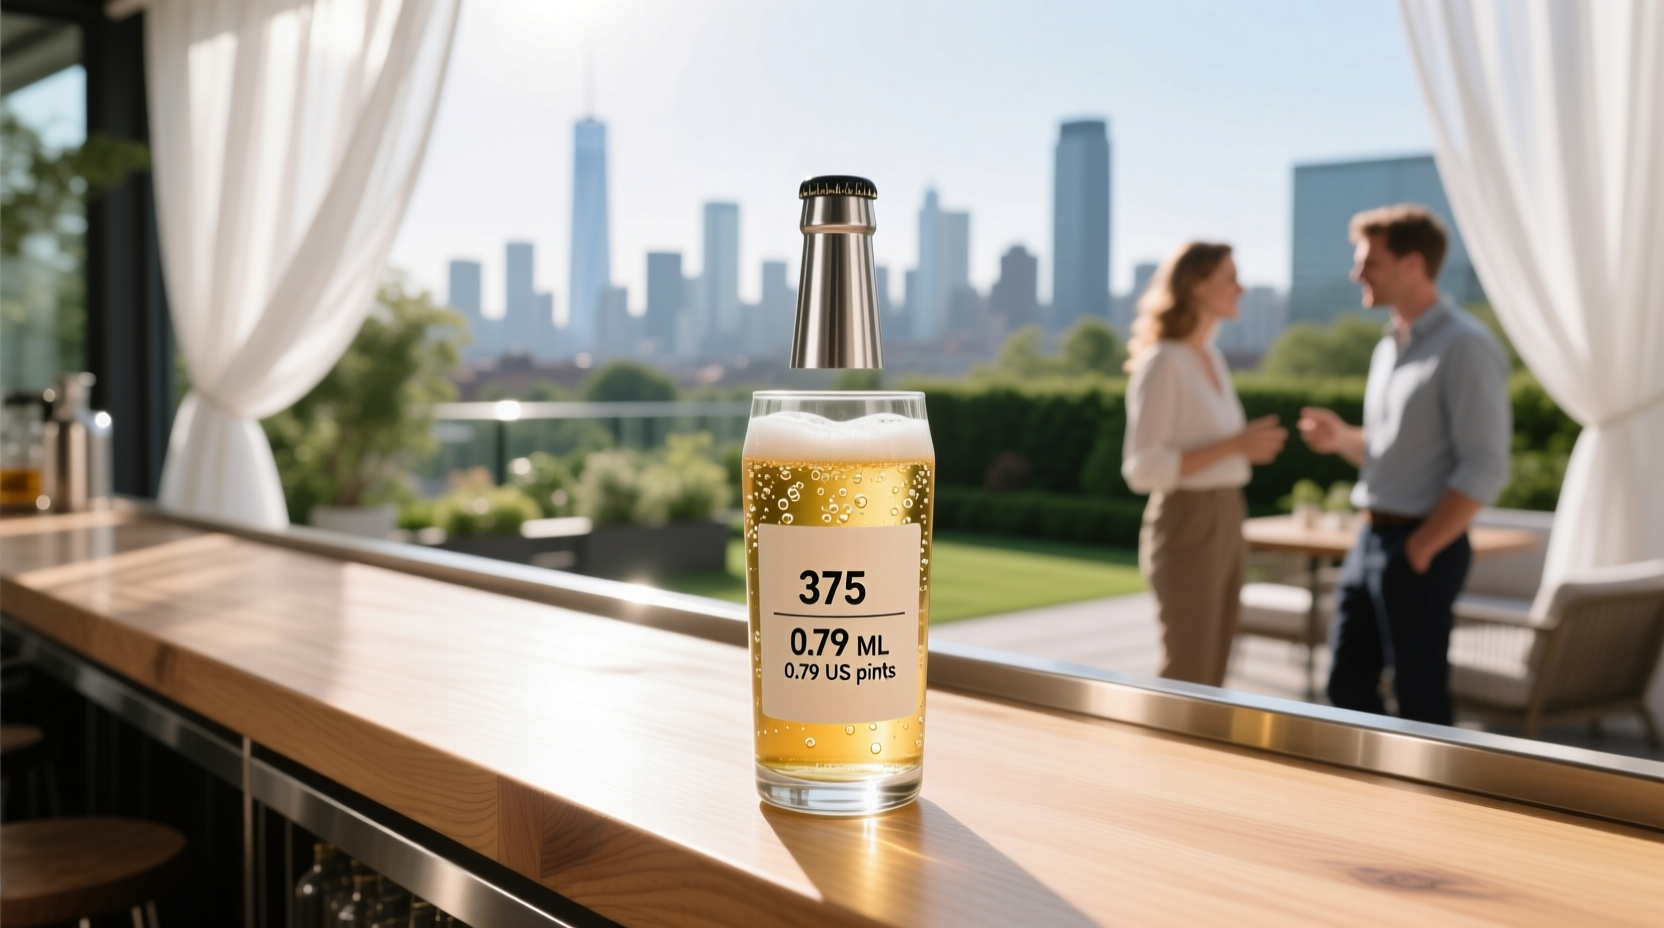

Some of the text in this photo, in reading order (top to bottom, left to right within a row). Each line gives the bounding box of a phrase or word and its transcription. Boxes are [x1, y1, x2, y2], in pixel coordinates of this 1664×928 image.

[799, 570, 866, 605] 375
[790, 627, 889, 656] 0.79 ML
[784, 662, 896, 685] 0.79 US pints
